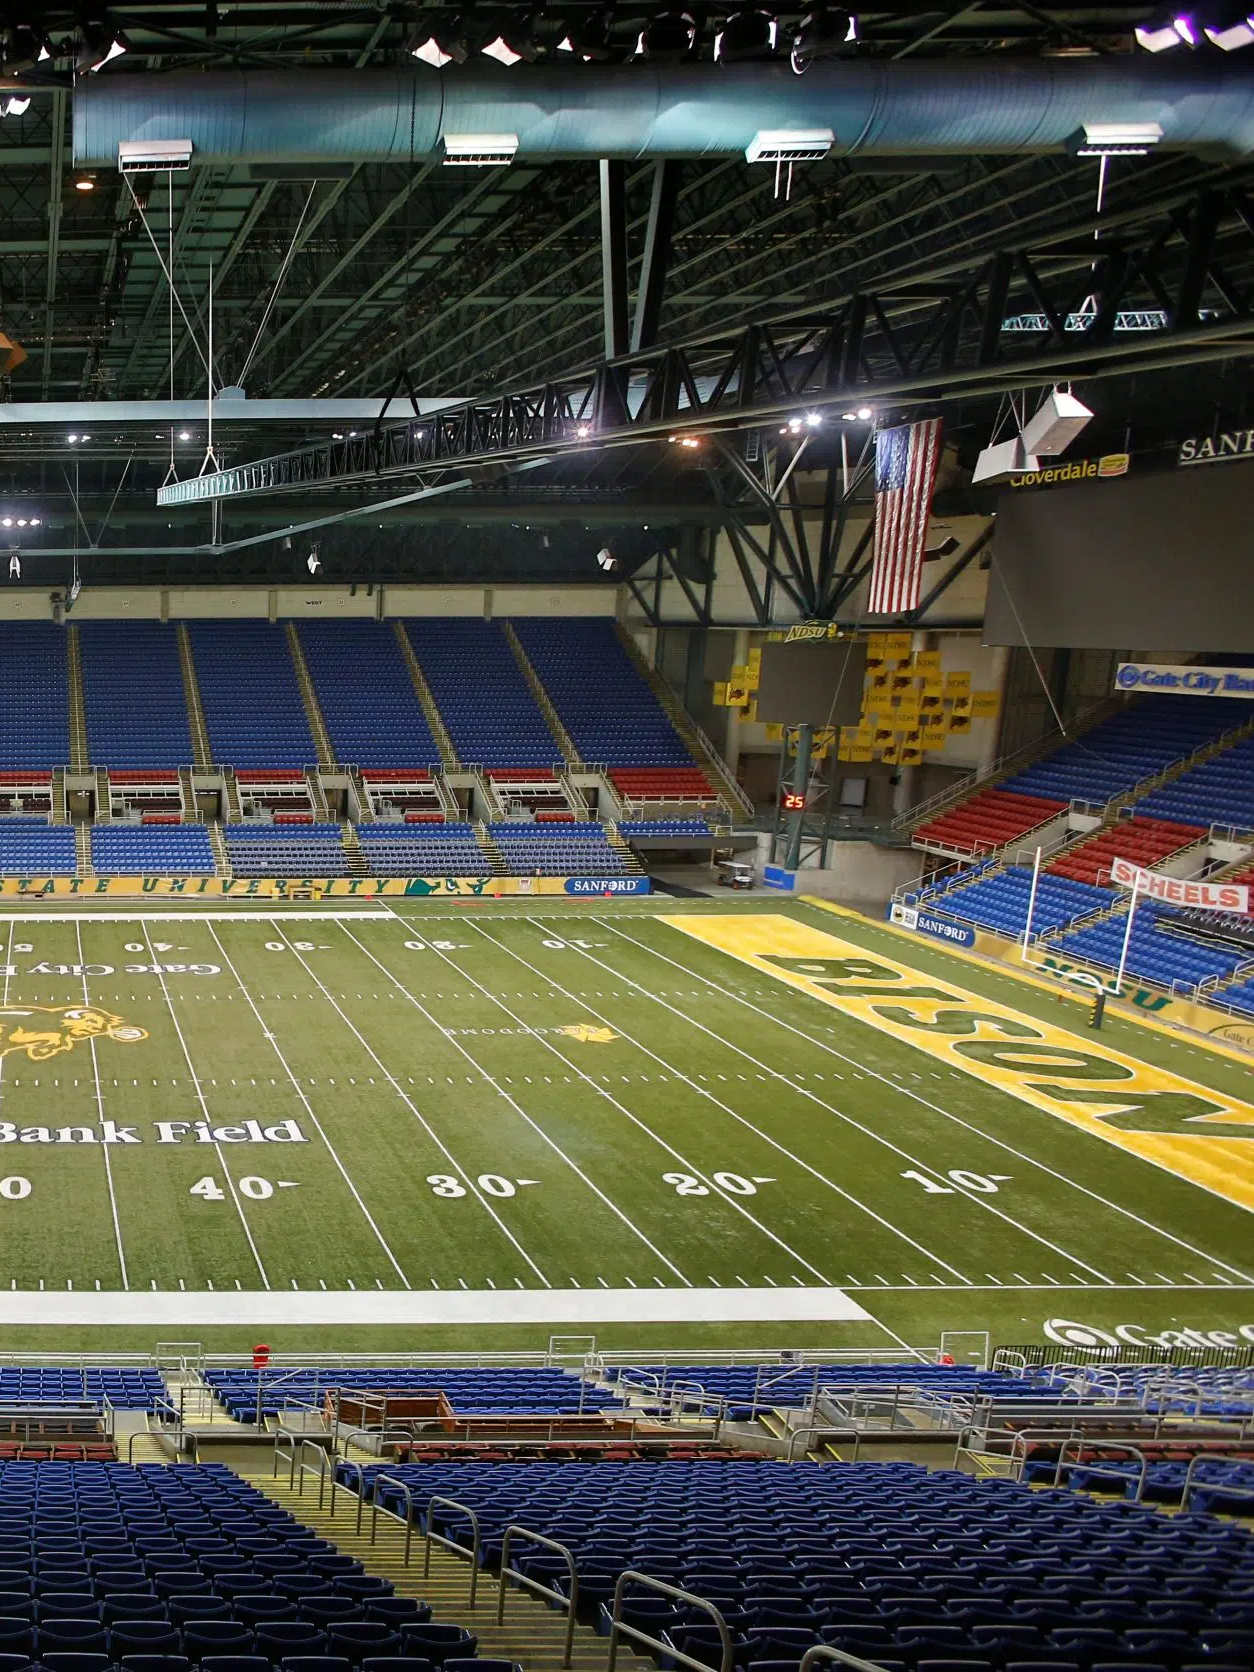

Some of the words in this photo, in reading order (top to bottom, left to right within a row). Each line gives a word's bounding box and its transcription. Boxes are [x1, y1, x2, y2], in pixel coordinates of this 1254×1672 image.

[788, 626, 826, 639] NDSU
[786, 795, 803, 808] 25
[574, 880, 639, 891] SANFORD
[1116, 863, 1241, 908] SCHEELS
[918, 916, 968, 941] SANFORD
[29, 962, 115, 976] City
[124, 964, 222, 975] Gate
[1036, 958, 1174, 1012] NDSU
[751, 953, 1254, 1141] BISON
[153, 1118, 310, 1144] Field
[188, 1175, 275, 1200] 40
[425, 1173, 519, 1198] 30
[661, 1172, 758, 1197] 20
[898, 1169, 1000, 1194] 10
[1115, 1324, 1240, 1350] Gate
